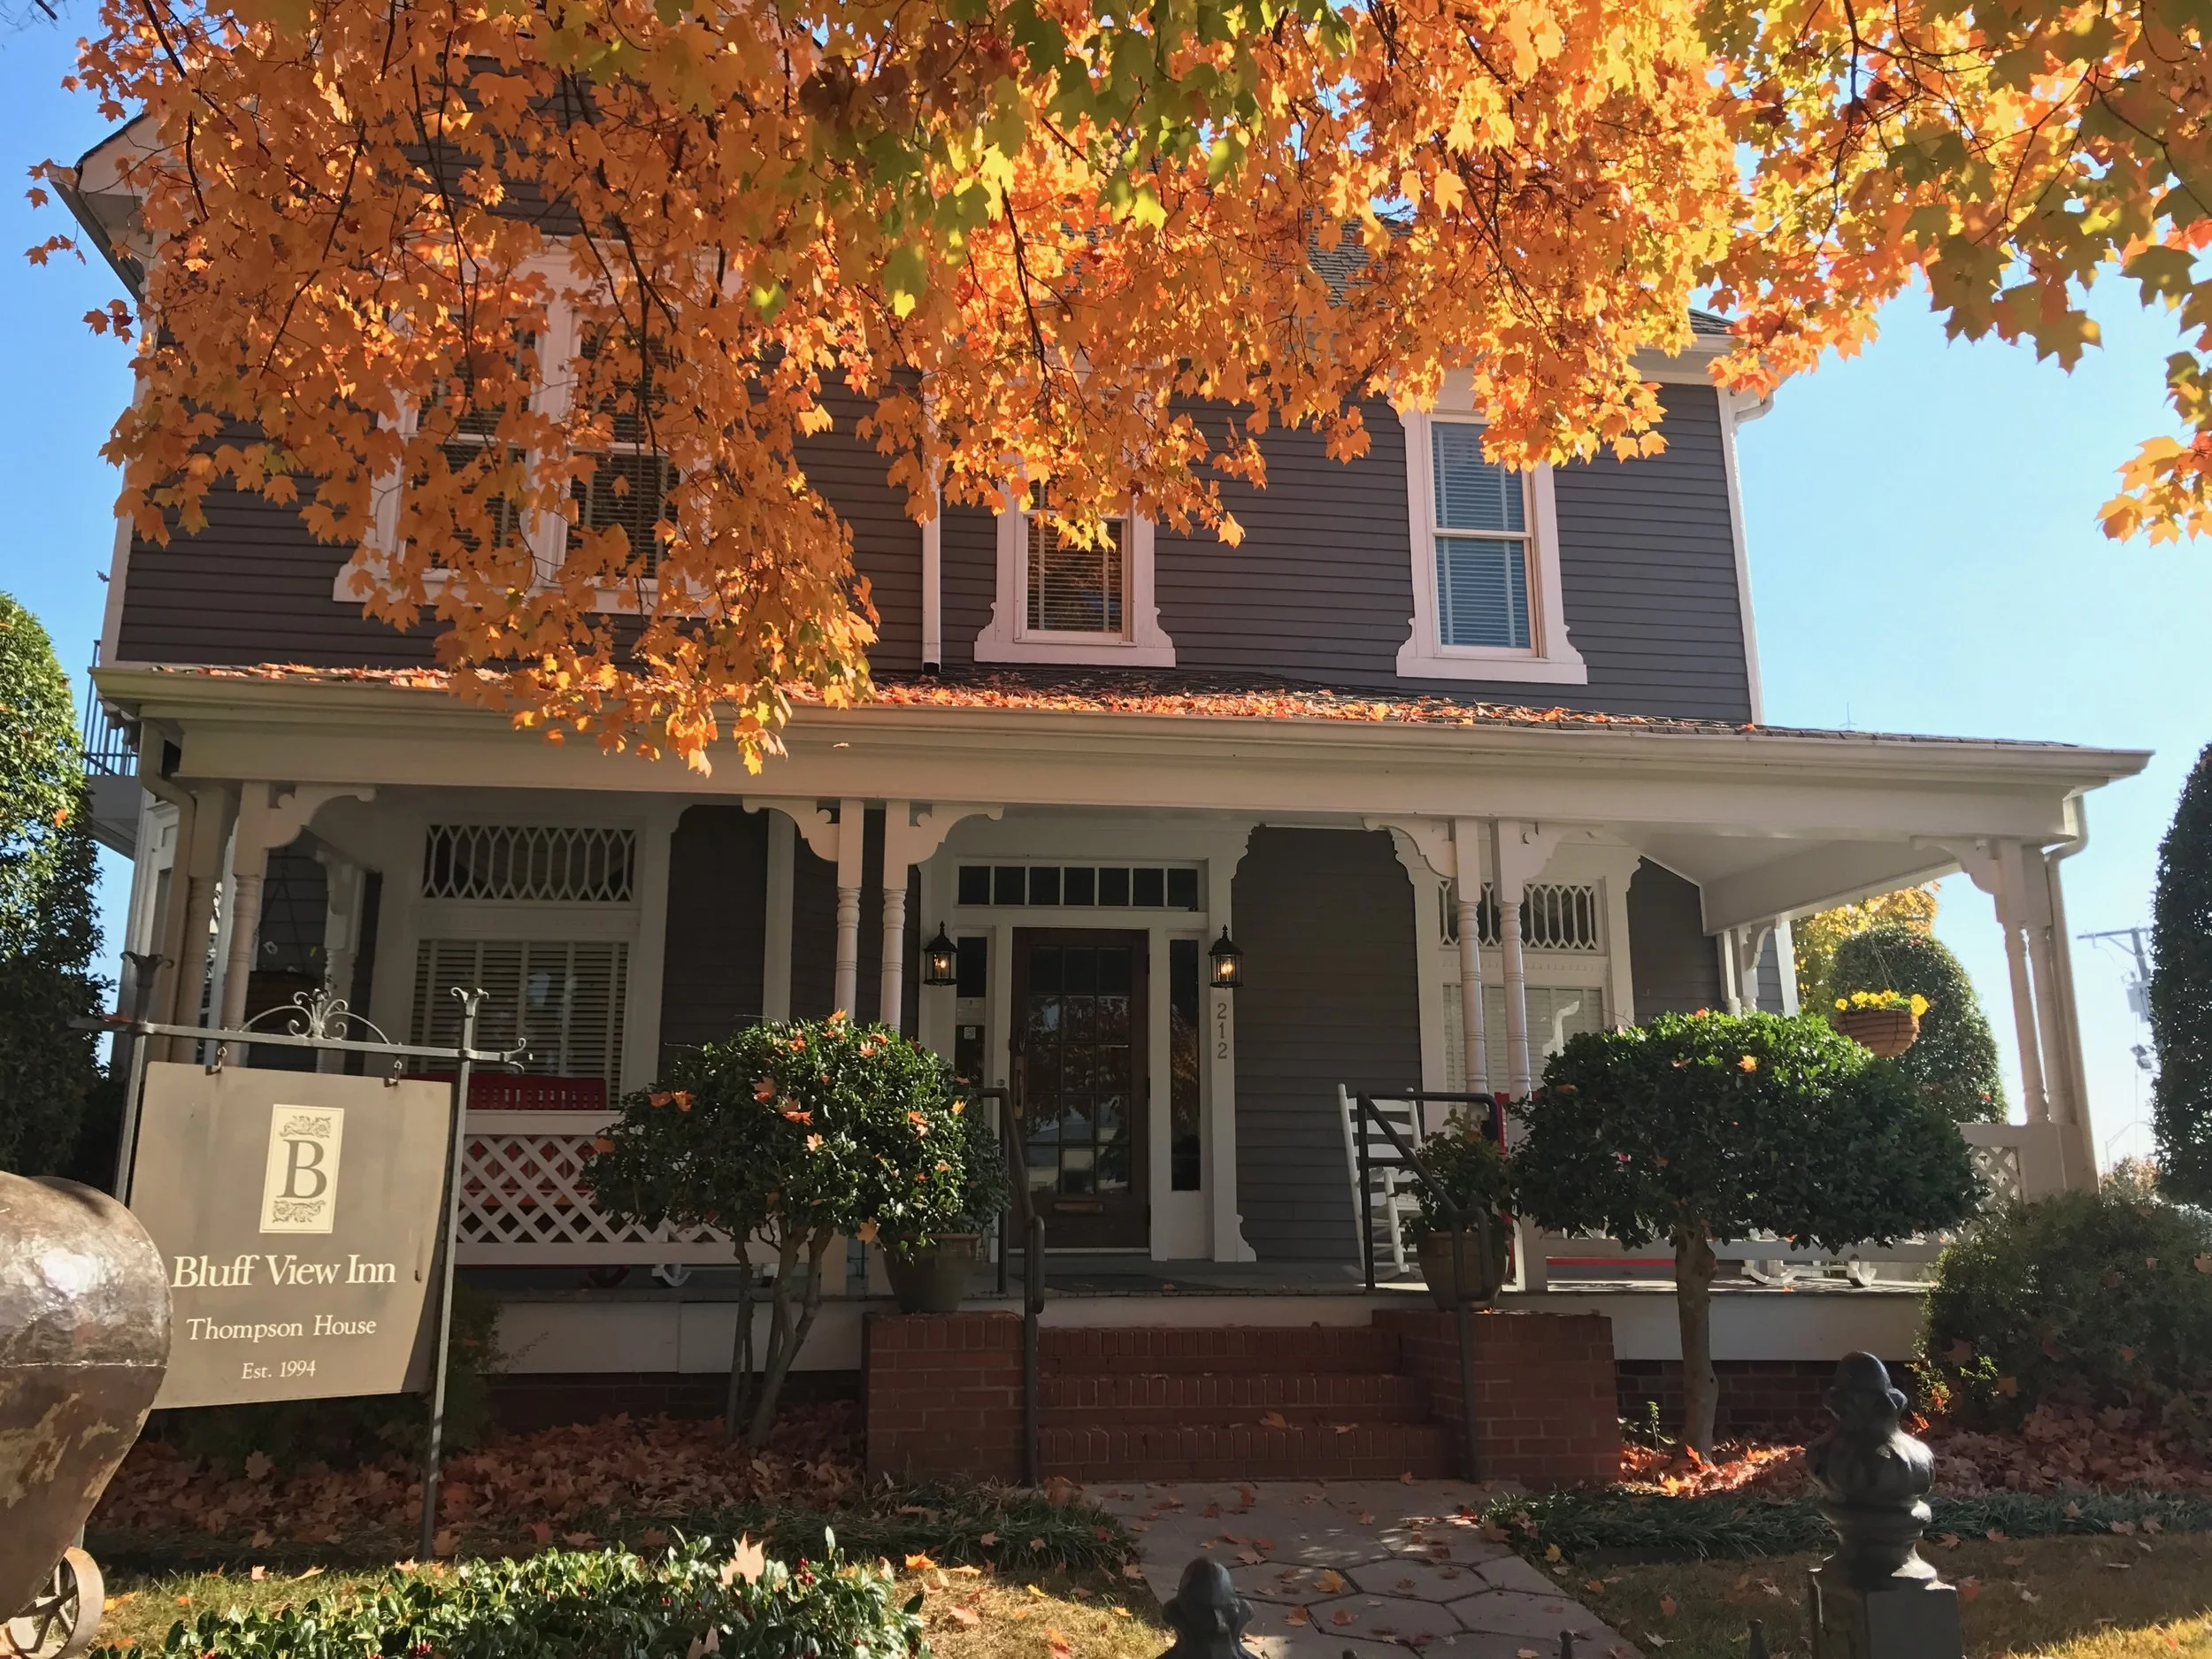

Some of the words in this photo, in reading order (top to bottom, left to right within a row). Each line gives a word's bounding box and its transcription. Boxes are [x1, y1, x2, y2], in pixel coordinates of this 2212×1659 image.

[1217, 1002, 1228, 1059] 212
[275, 1139, 327, 1199] B
[171, 1255, 260, 1287] Bluff
[265, 1254, 342, 1286] View
[345, 1254, 397, 1284] Inn
[186, 1317, 303, 1343] Thompson
[312, 1314, 377, 1336] House
[241, 1362, 273, 1379] Est.
[280, 1359, 316, 1378] 1994
